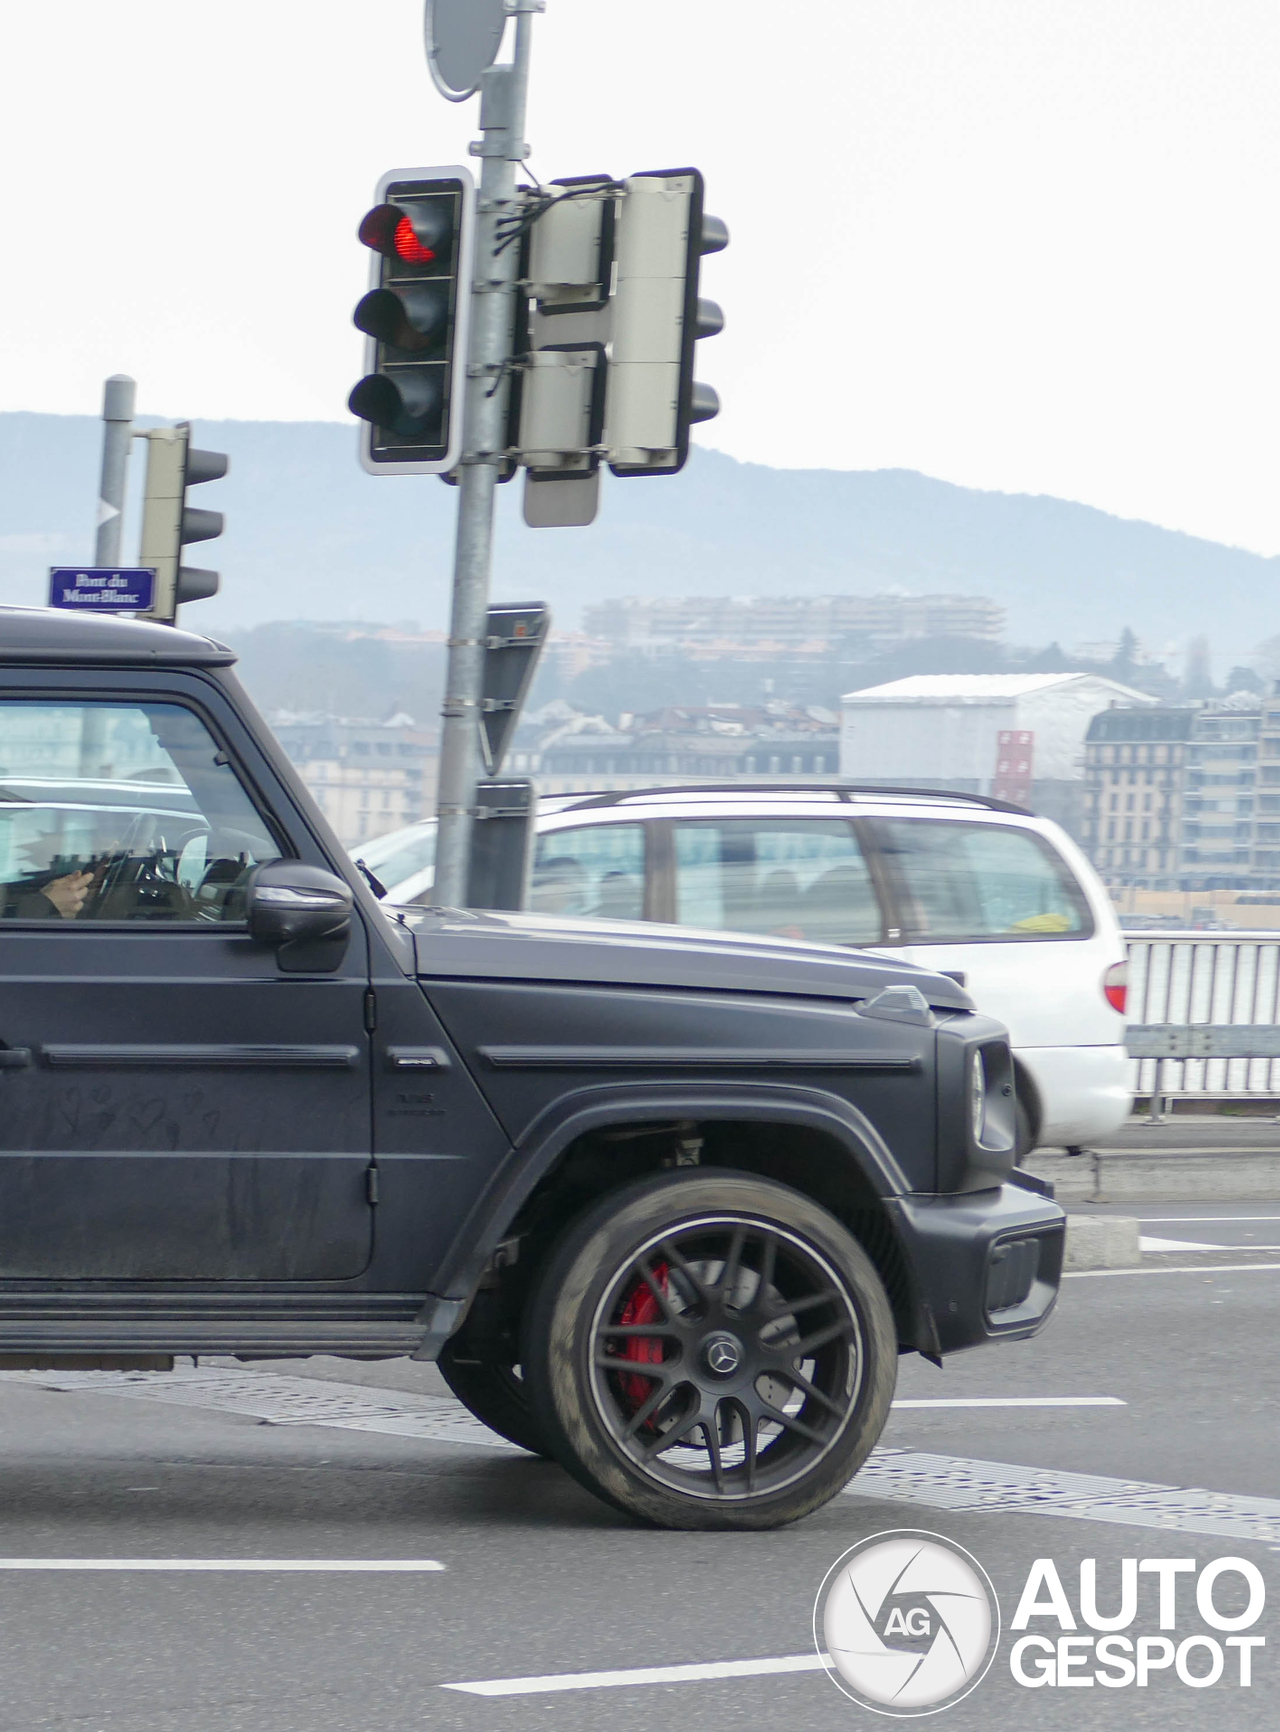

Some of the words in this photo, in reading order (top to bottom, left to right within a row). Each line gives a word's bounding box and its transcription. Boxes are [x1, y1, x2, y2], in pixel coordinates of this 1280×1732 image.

[75, 573, 107, 587] Pont
[107, 573, 128, 588] du
[62, 588, 140, 603] Mont-Blanc
